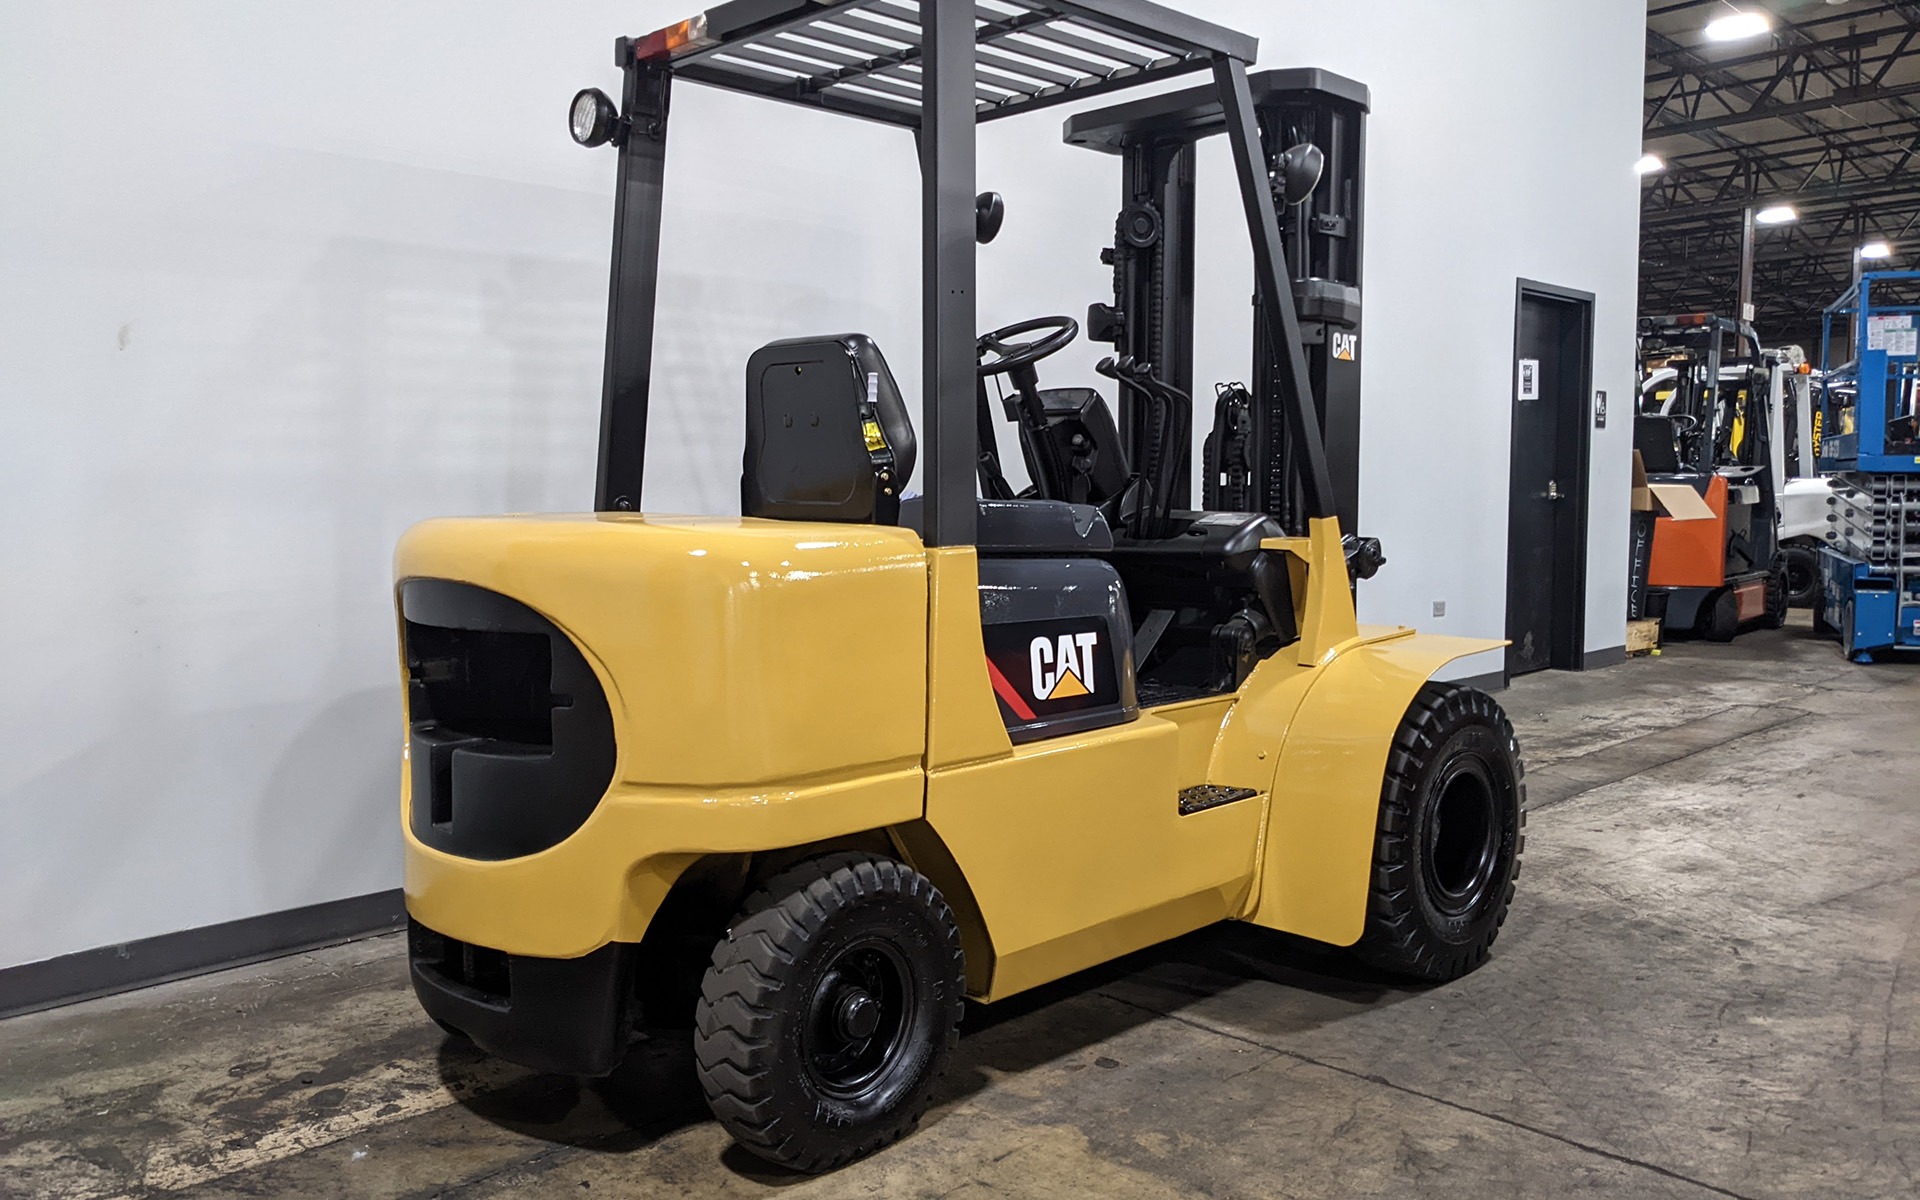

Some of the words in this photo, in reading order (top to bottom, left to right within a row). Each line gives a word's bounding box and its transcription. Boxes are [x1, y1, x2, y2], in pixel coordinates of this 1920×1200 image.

[1332, 332, 1357, 361] CAT
[1631, 522, 1647, 618] OFFICE
[1030, 632, 1097, 700] CAT
